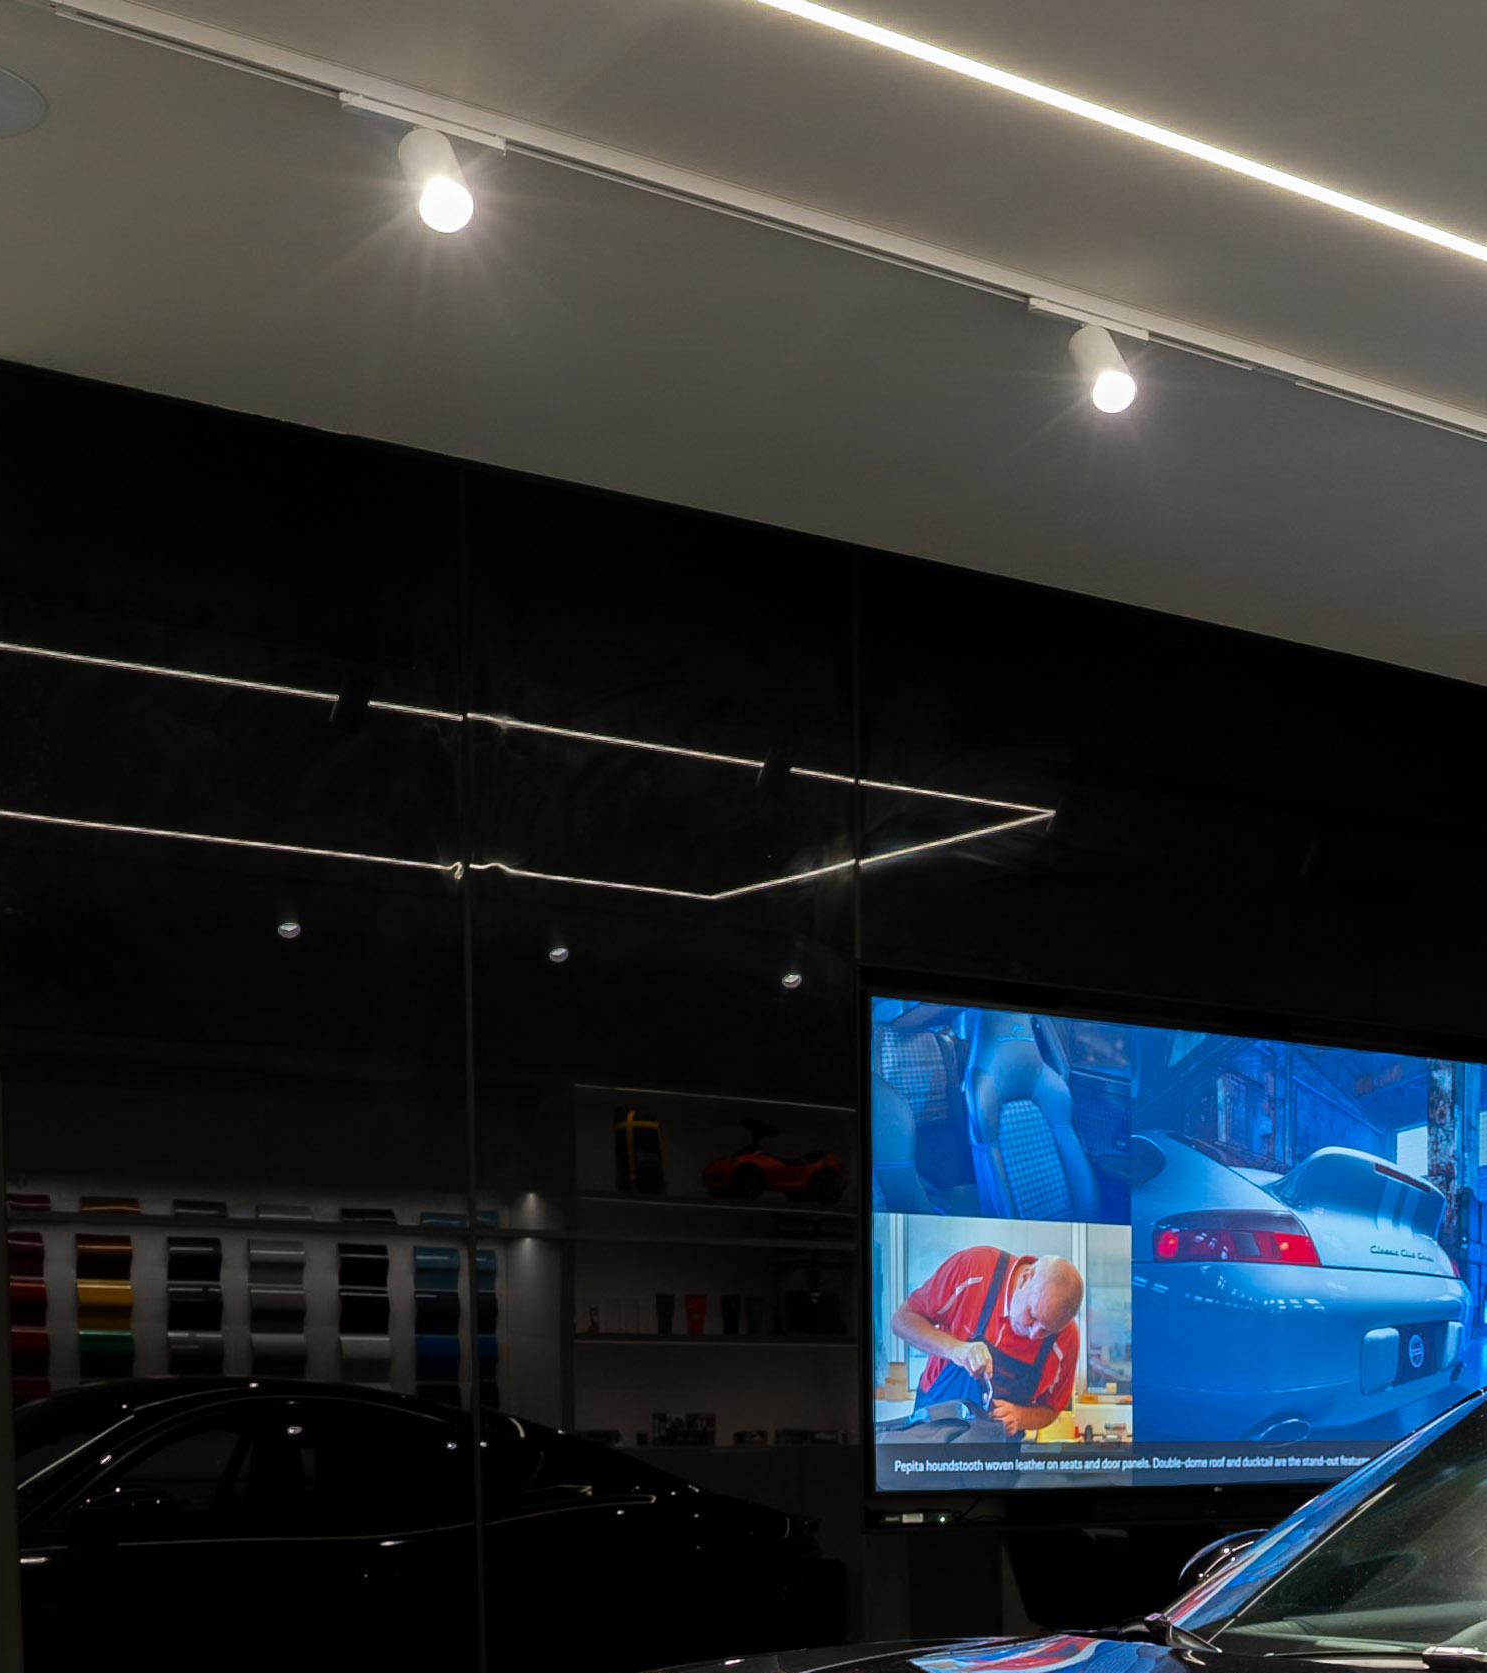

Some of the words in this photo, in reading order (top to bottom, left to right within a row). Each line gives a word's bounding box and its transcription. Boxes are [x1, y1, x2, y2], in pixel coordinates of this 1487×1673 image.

[894, 1459, 925, 1475] Pepita
[926, 1459, 984, 1472] houndstooth
[985, 1461, 1014, 1471] woven
[1015, 1458, 1046, 1471] leather
[1046, 1461, 1059, 1470] on
[1060, 1459, 1083, 1470] seats
[1084, 1457, 1100, 1470] and
[1101, 1457, 1121, 1469] door
[1122, 1457, 1152, 1472] panels.
[1153, 1457, 1208, 1469] Double-dome
[1209, 1456, 1226, 1468] roof
[1226, 1456, 1242, 1468] and
[1242, 1456, 1274, 1468] ducktail
[1274, 1457, 1287, 1467] are
[1288, 1456, 1301, 1467] the
[1302, 1455, 1339, 1467] stand-out
